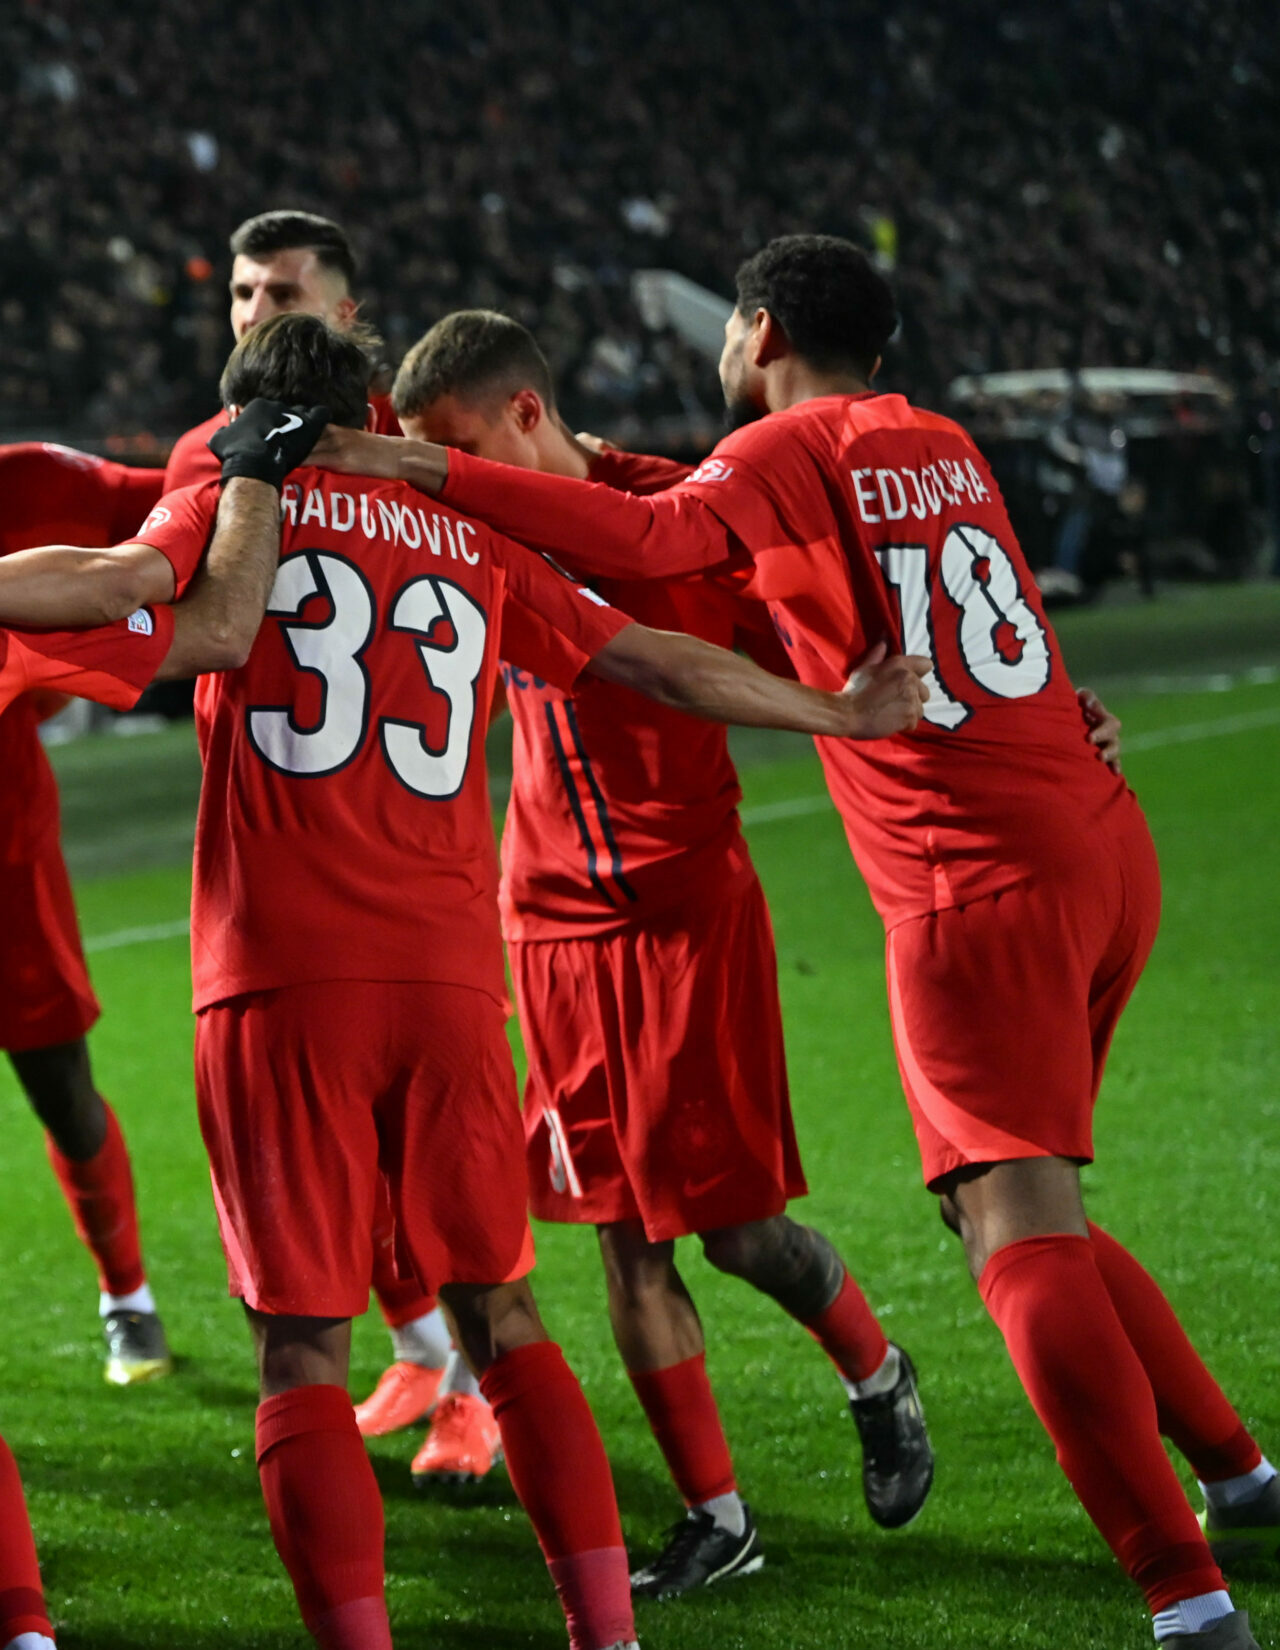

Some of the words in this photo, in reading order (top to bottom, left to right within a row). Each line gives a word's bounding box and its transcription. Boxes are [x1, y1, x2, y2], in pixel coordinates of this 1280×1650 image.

[279, 484, 480, 566] RADUNOVIC
[872, 522, 1051, 733] 18
[245, 548, 488, 802] 33
